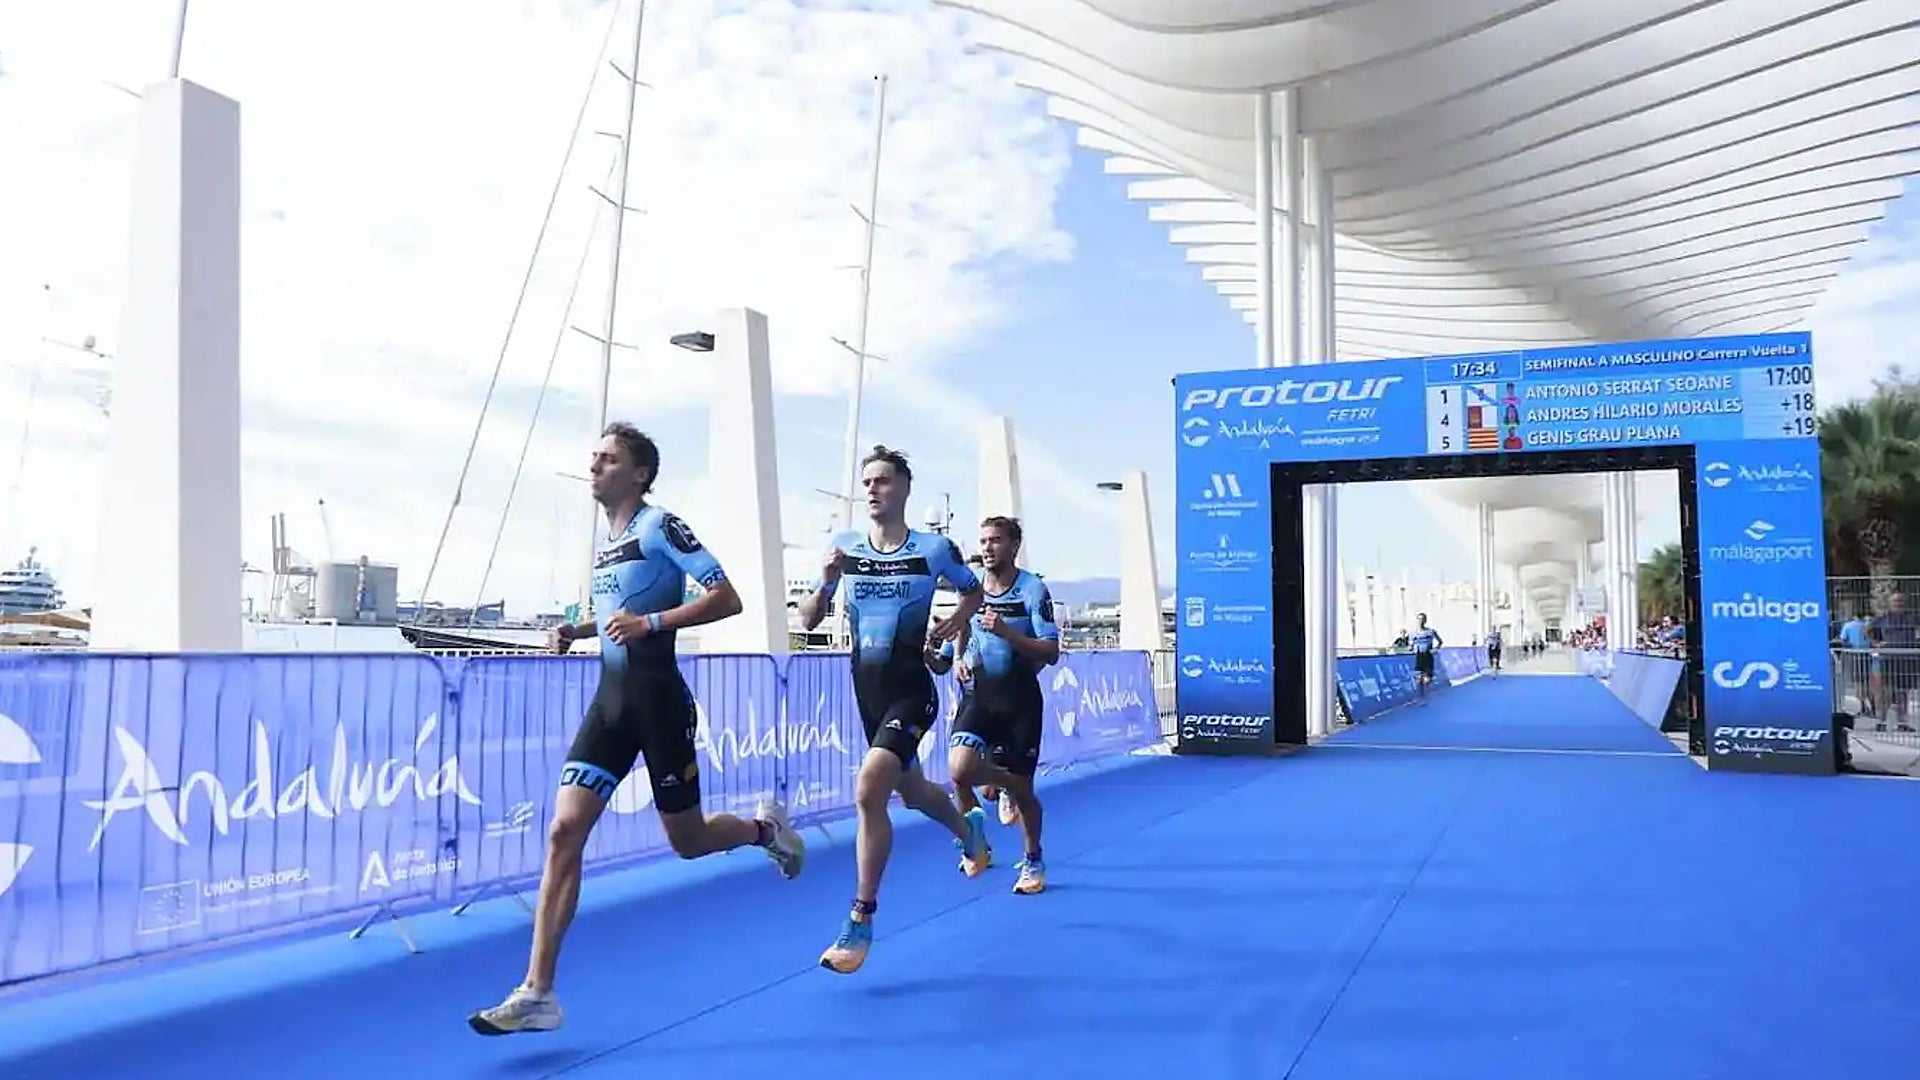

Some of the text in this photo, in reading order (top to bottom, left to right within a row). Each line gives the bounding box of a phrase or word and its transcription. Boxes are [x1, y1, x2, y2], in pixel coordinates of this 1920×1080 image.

[1524, 357, 1596, 372] SEMIFINAL
[1599, 355, 1610, 368] A
[1612, 350, 1695, 366] MASCULINO
[1699, 348, 1748, 361] Carrera
[1750, 345, 1796, 358] Vuelta
[1451, 361, 1497, 378] 17:34
[1766, 366, 1813, 387] 17:00
[1182, 375, 1403, 411] protour
[1439, 389, 1448, 404] 1
[1524, 375, 1732, 400] ANTONIO SERRAT SEOANE
[1527, 398, 1743, 424] ANDRES HILARIO MORALES
[1783, 394, 1813, 412] +18
[1441, 414, 1450, 428] 4
[1783, 416, 1814, 436] +19
[1441, 434, 1450, 449] 5
[1528, 423, 1681, 446] GENIS GRAU PLANA
[1709, 541, 1815, 563] málagaport
[1712, 592, 1819, 623] málaga
[1183, 713, 1271, 727] protour
[1714, 726, 1830, 741] protour
